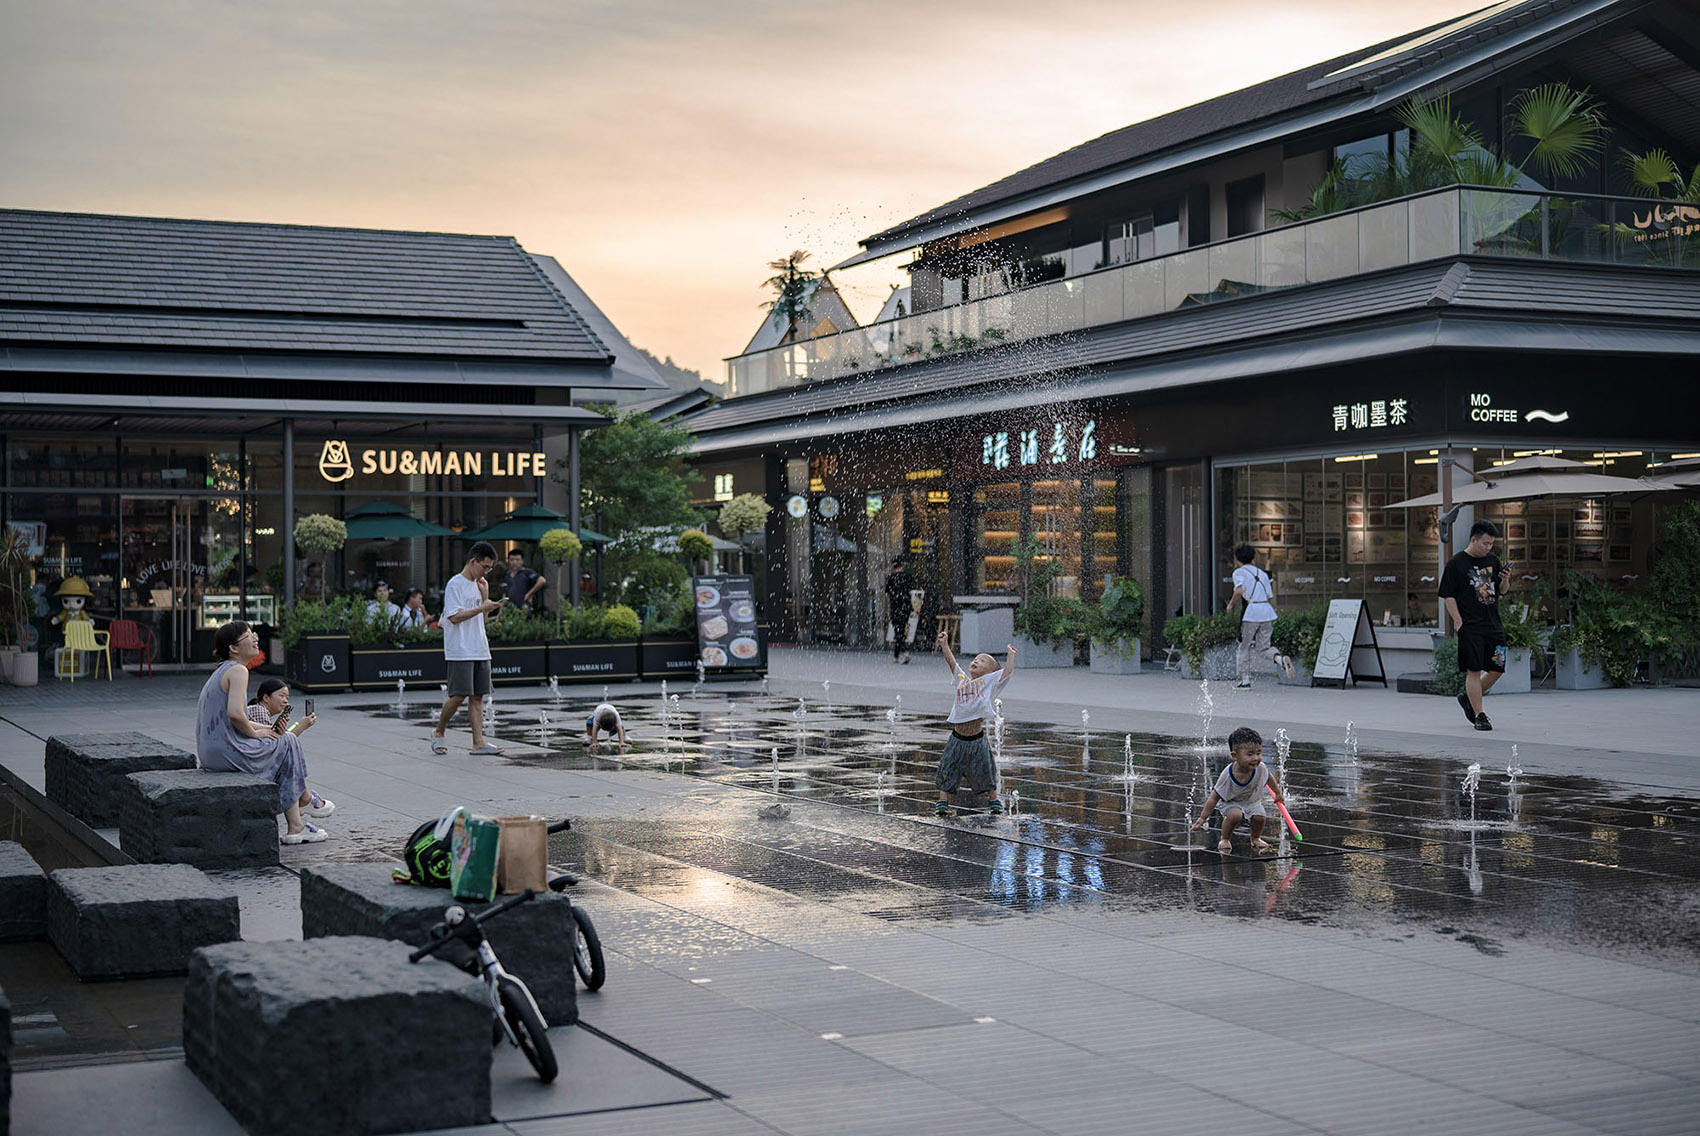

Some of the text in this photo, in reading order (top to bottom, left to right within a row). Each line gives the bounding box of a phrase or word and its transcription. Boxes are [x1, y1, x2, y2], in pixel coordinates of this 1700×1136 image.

[1471, 394, 1490, 406] MO
[1332, 398, 1408, 431] 青咖墨茶
[1471, 409, 1518, 423] COFFEE
[361, 449, 547, 477] SU&MAN LIFE
[136, 563, 159, 584] LOVE
[182, 561, 206, 576] LOVE
[378, 669, 422, 678] SU&MAN LIFE
[600, 663, 613, 671] LIFE
